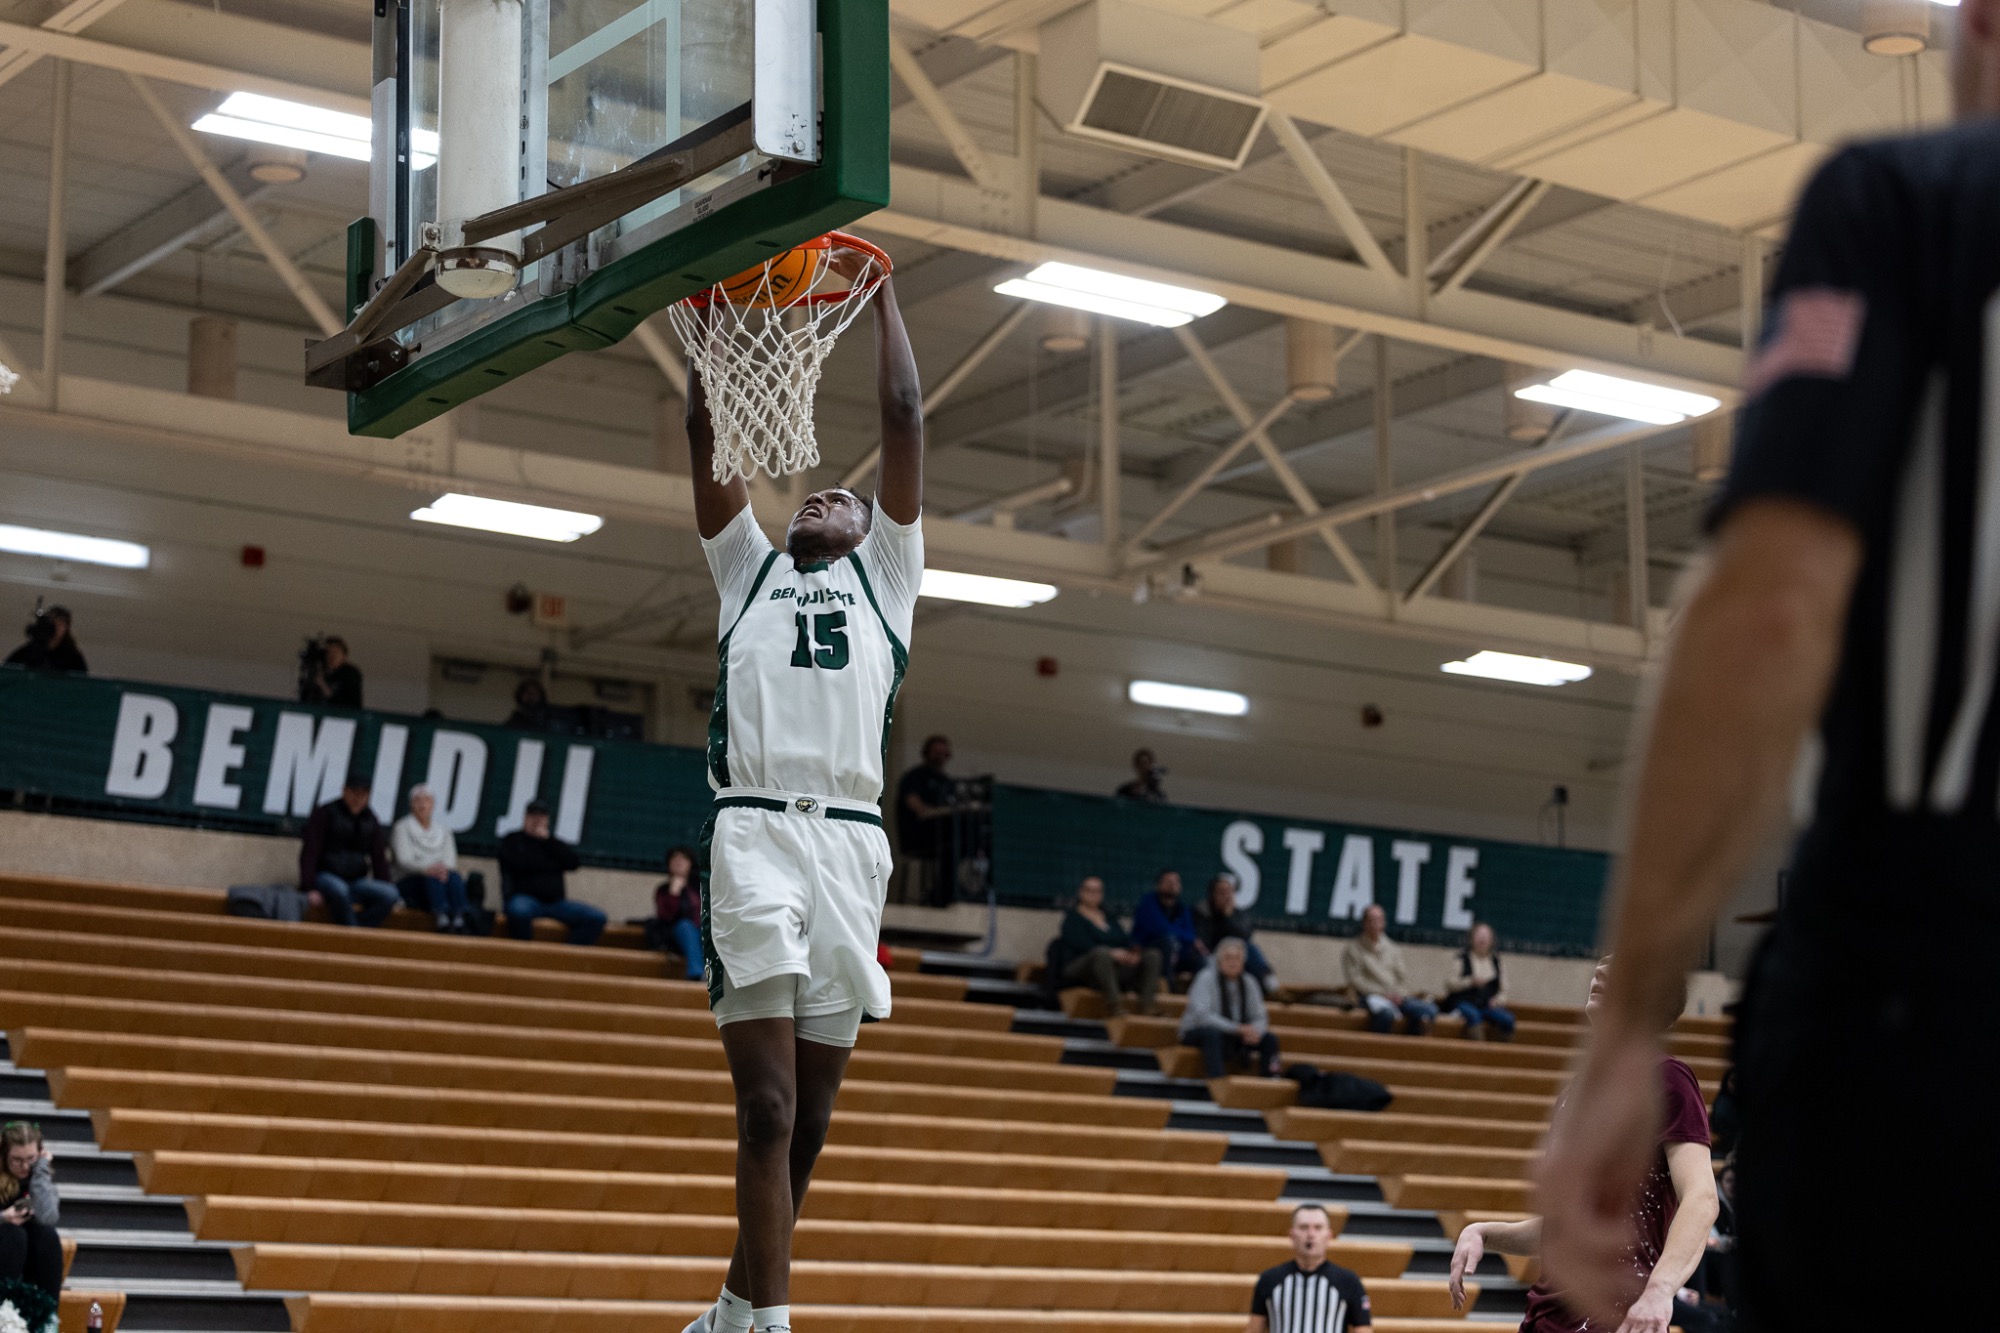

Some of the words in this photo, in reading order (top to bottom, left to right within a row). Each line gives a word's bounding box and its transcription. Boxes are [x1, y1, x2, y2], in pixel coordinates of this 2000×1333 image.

[729, 274, 793, 304] Wilso
[826, 588, 856, 607] STTE
[790, 610, 850, 670] 15
[105, 692, 595, 845] BEMIDJI
[1221, 820, 1480, 931] STATE
